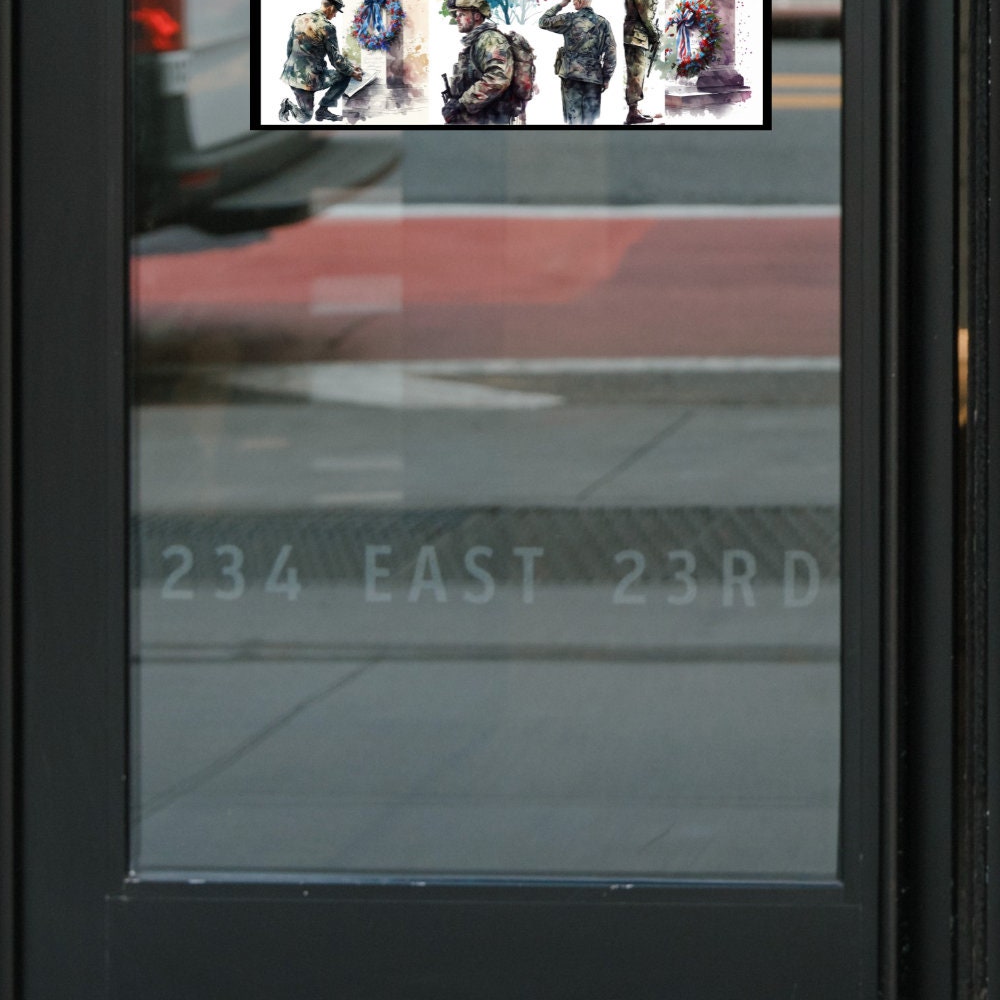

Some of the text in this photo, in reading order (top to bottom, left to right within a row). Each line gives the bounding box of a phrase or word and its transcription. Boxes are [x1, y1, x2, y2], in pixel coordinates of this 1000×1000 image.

[160, 544, 820, 608] 234 EAST 23RD
